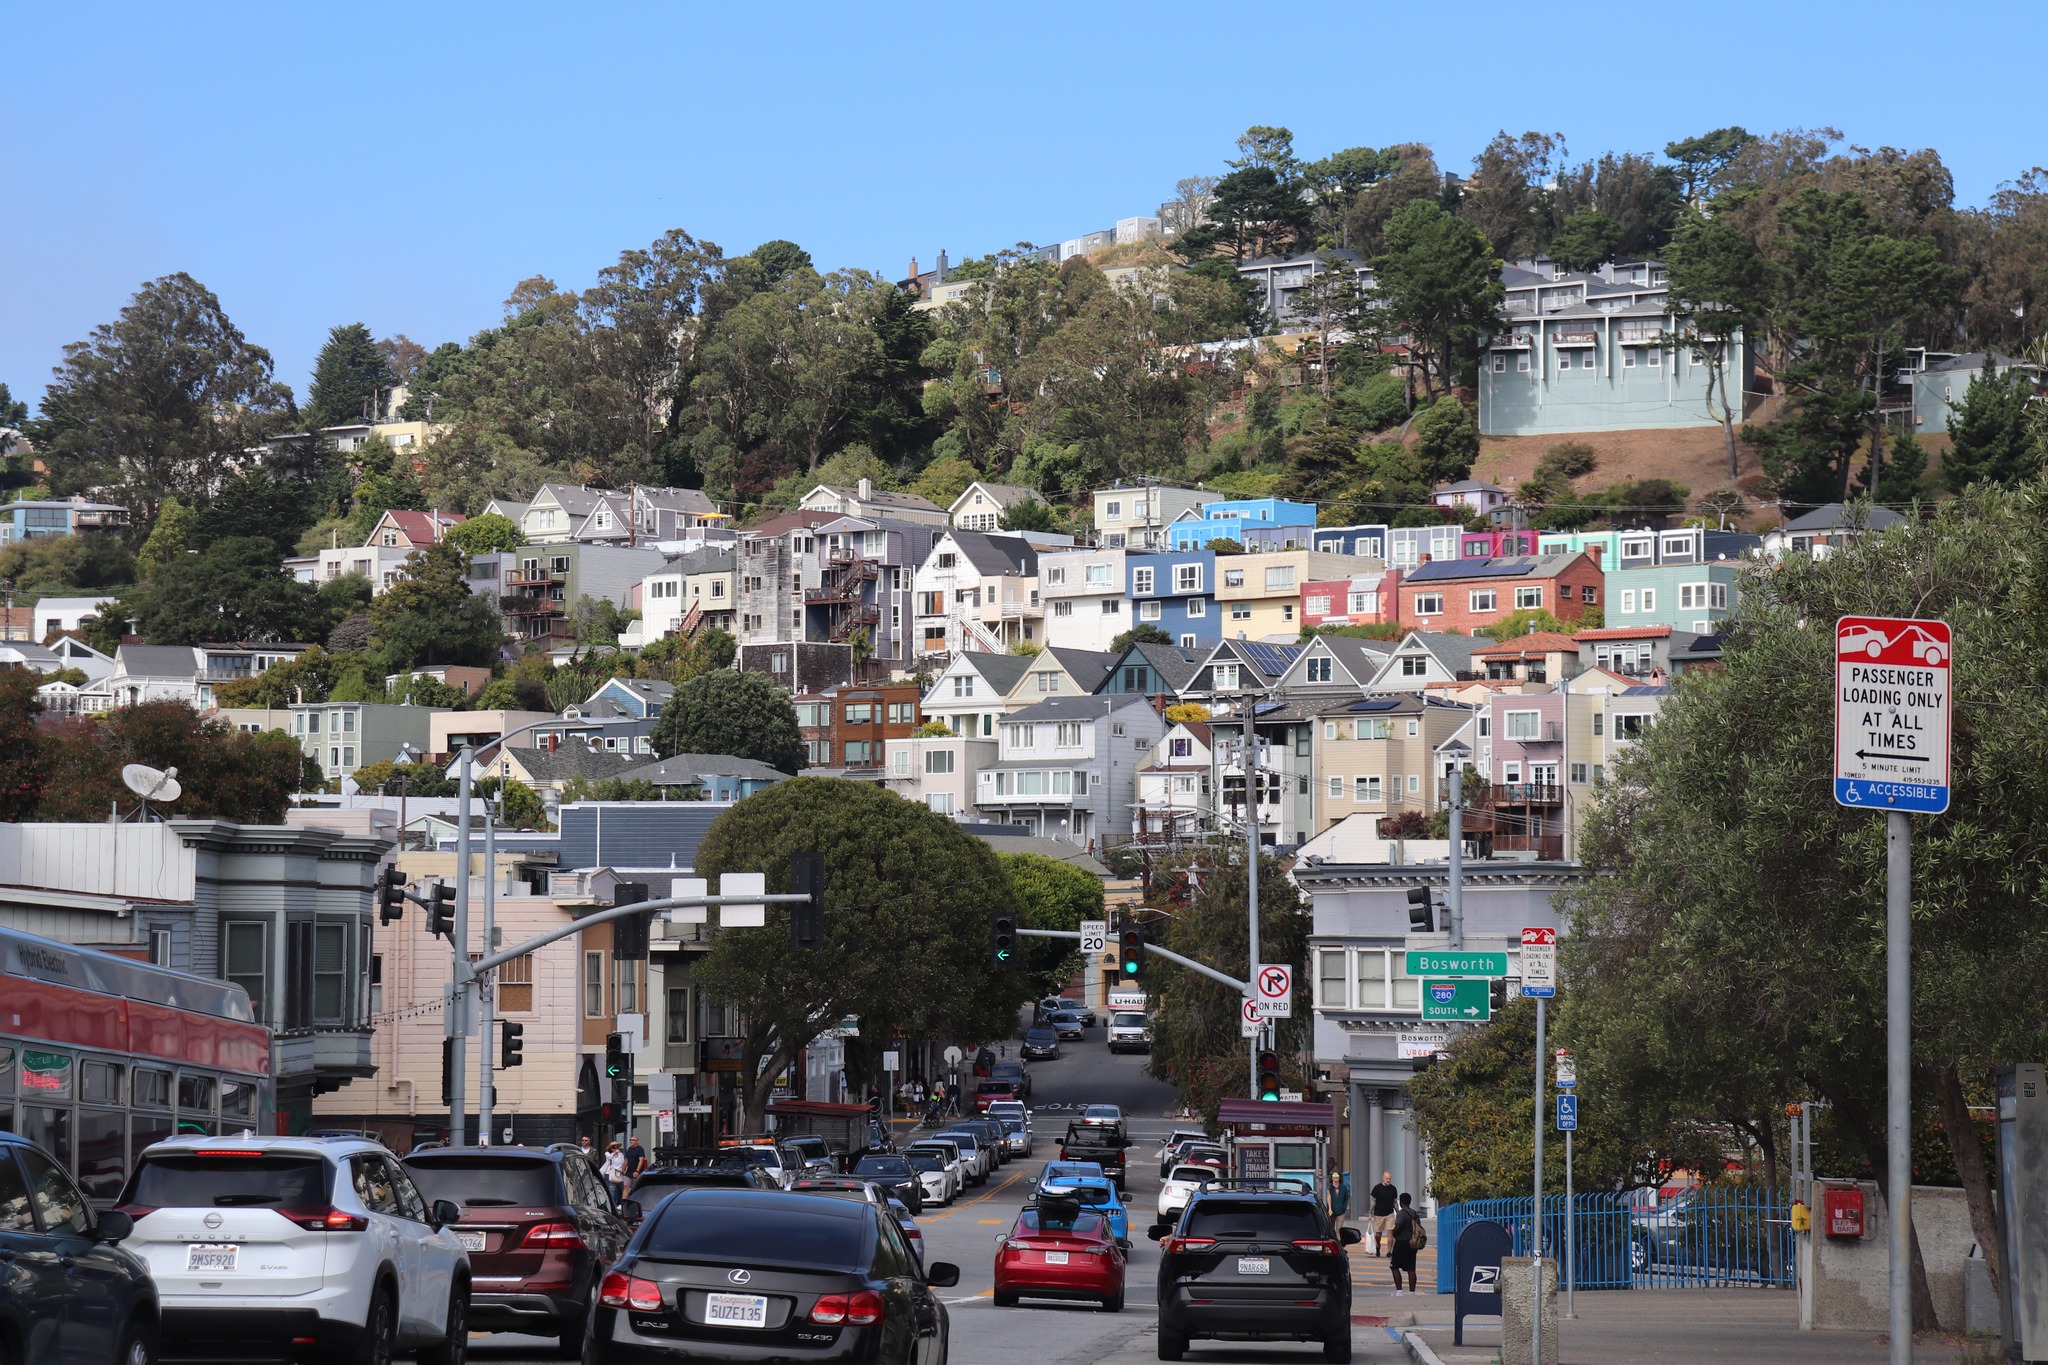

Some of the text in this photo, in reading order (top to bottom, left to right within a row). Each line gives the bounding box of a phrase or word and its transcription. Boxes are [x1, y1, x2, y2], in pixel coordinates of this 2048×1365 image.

[1852, 668, 1934, 687] PASSENGER
[1843, 688, 1942, 708] LOADING ONLY
[1862, 712, 1923, 730] AT ALL
[1868, 732, 1916, 750] TIMES
[1871, 764, 1898, 772] MINUTE
[1902, 766, 1921, 774] LIMIT
[1903, 777, 1940, 785] 415-553-1235
[1868, 784, 1937, 800] ACCESSIBLE
[1084, 938, 1103, 949] 20
[17, 943, 68, 975] Hybrid Electric
[1420, 957, 1494, 970] Bosworth
[1259, 1002, 1288, 1011] ON RED
[1245, 1150, 1262, 1158] TAKE
[191, 1254, 235, 1265] 9MSF920
[711, 1304, 761, 1321] 5UZE135
[636, 1320, 669, 1328] LEXUS
